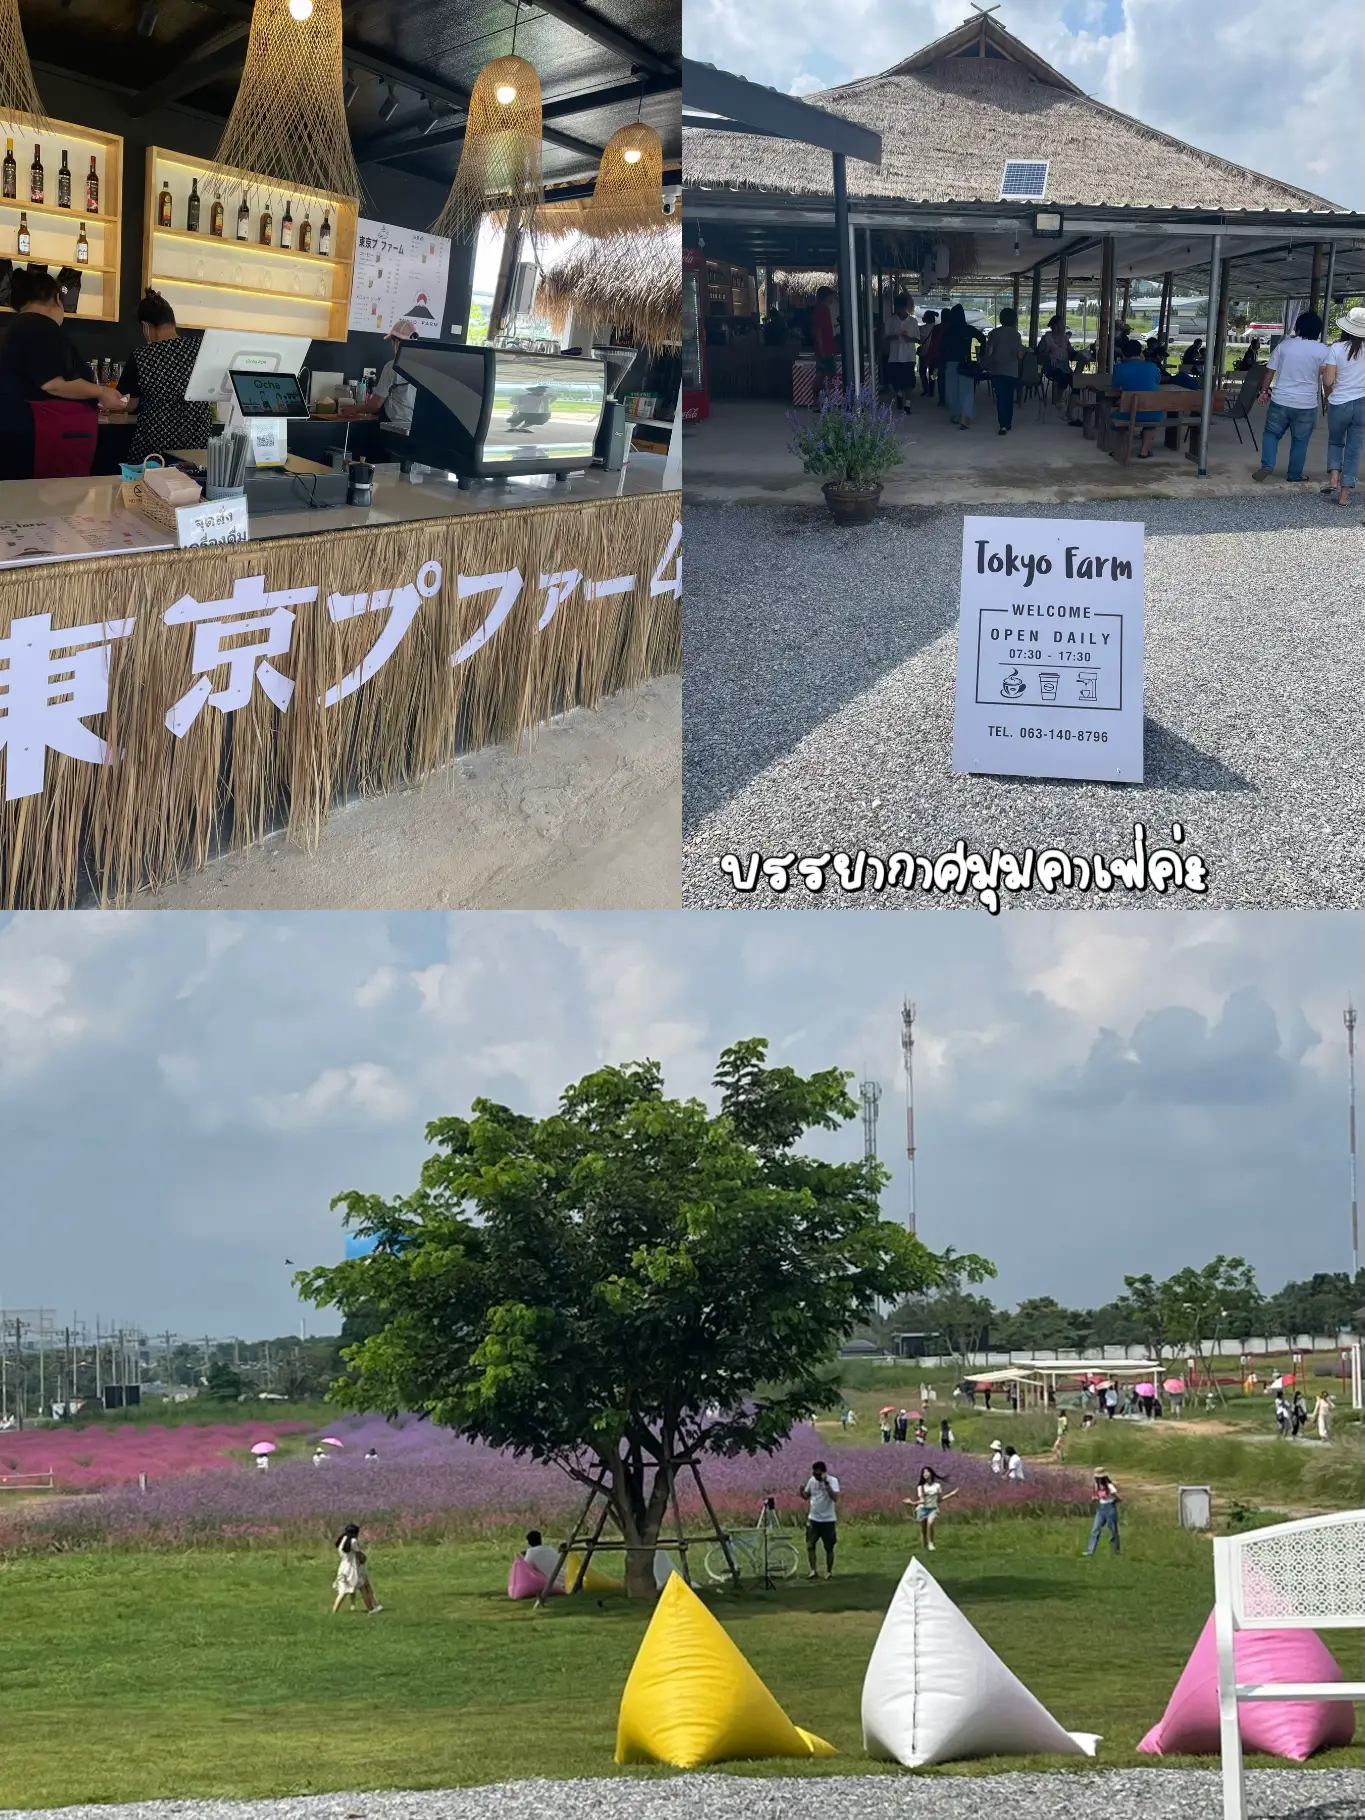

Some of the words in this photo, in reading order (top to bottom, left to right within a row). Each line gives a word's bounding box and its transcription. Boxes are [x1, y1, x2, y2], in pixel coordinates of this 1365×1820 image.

[254, 380, 281, 390] Ocha
[974, 540, 1053, 588] Tokyo
[1065, 546, 1133, 582] Farm
[1012, 604, 1092, 619] WELCOME
[990, 628, 1040, 643] OPEN
[1053, 631, 1112, 646] DAILY
[1009, 648, 1042, 660] 07:30
[1059, 651, 1092, 662] 17:30
[988, 725, 1014, 738] TEL.
[1020, 727, 1109, 743] 063-140-8796
